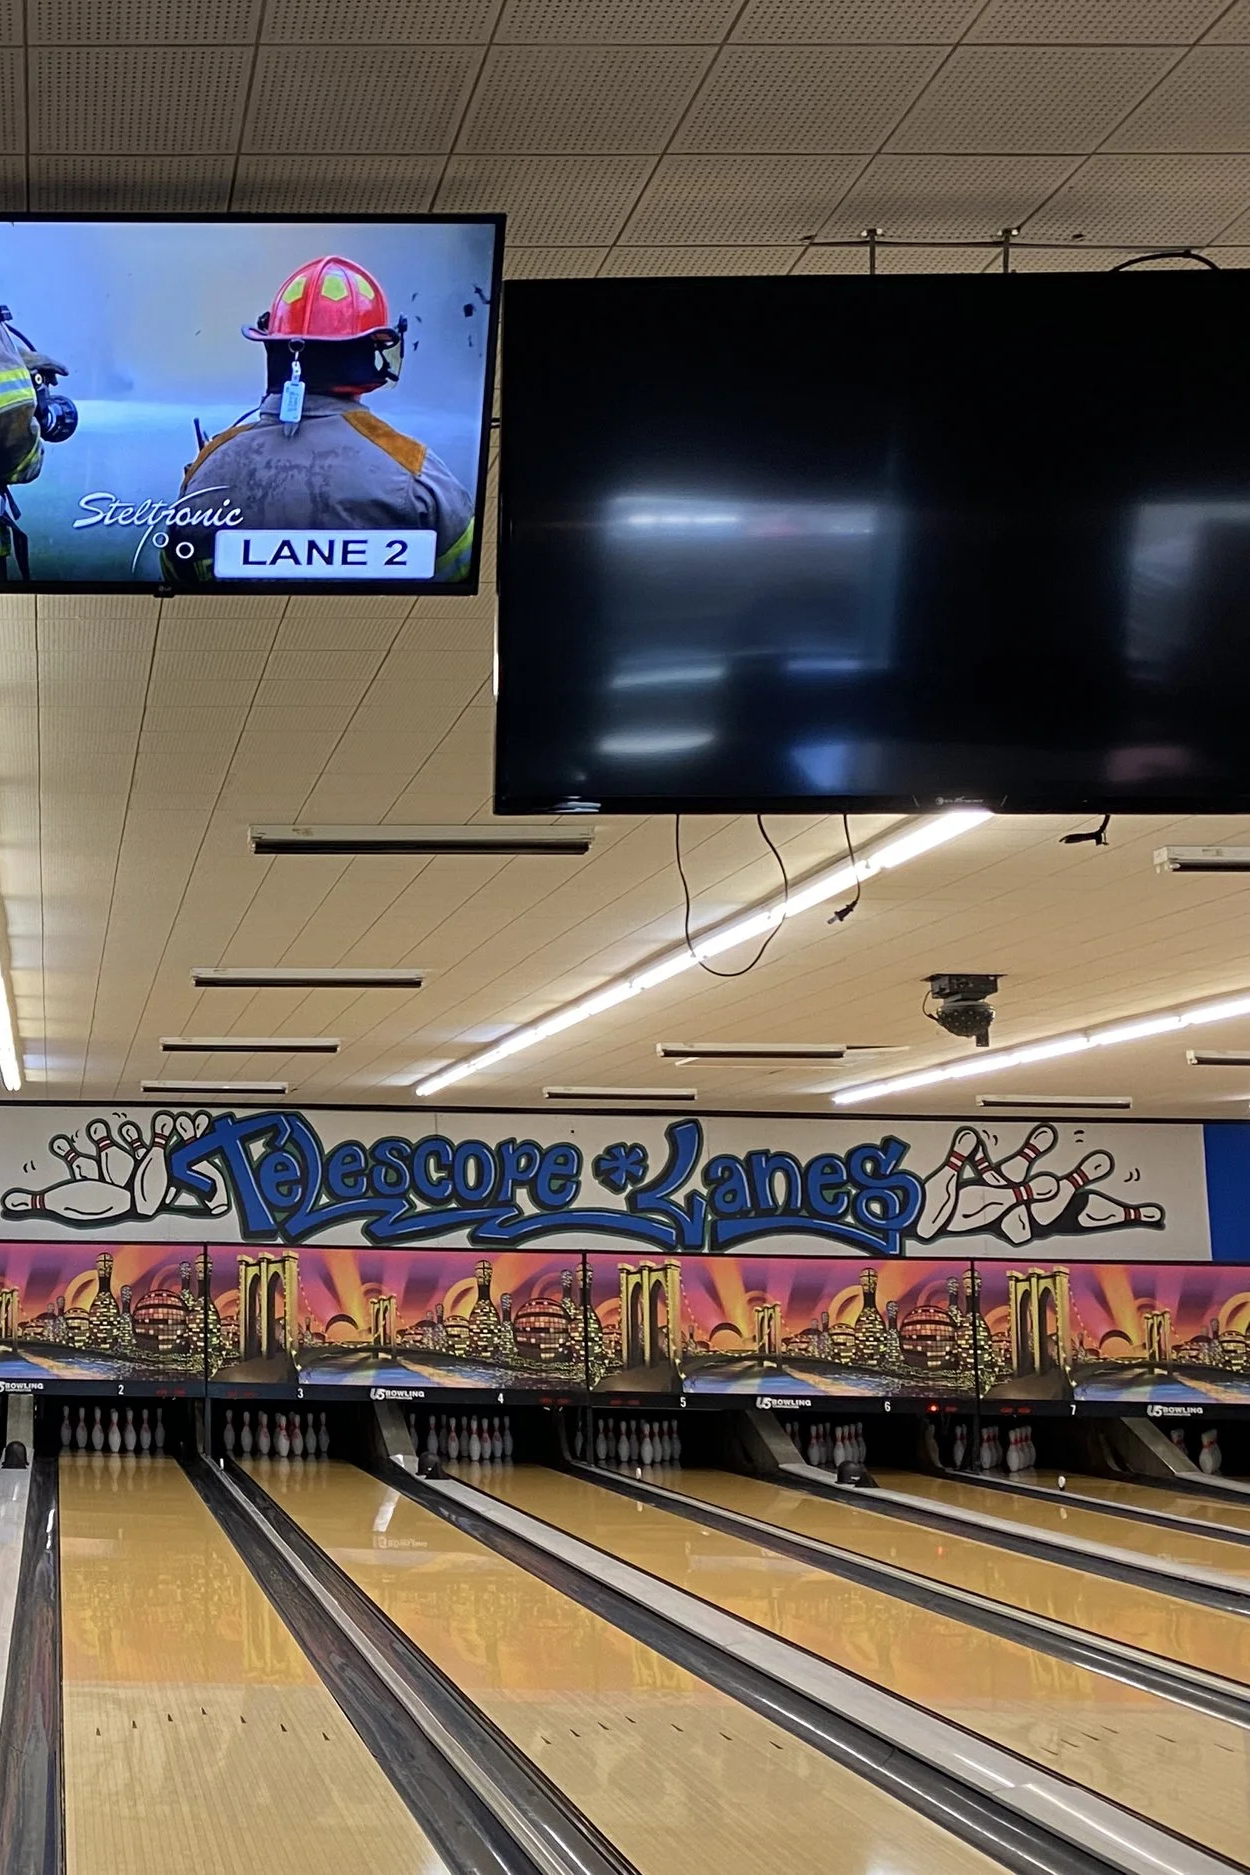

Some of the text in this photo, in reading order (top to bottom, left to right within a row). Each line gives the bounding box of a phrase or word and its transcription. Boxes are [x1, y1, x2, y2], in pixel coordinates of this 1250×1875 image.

[73, 486, 244, 533] Steltronic
[242, 539, 408, 566] LANE 2
[5, 1382, 45, 1390] BOWLING
[118, 1384, 125, 1395] 2
[297, 1387, 304, 1398] 3
[385, 1390, 425, 1398] BOWLING
[497, 1393, 504, 1404] 4
[680, 1397, 687, 1408] 5
[771, 1399, 812, 1407] BOWLING
[884, 1401, 891, 1412] 6
[1070, 1404, 1077, 1415] 7
[1162, 1406, 1204, 1414] BOWLING
